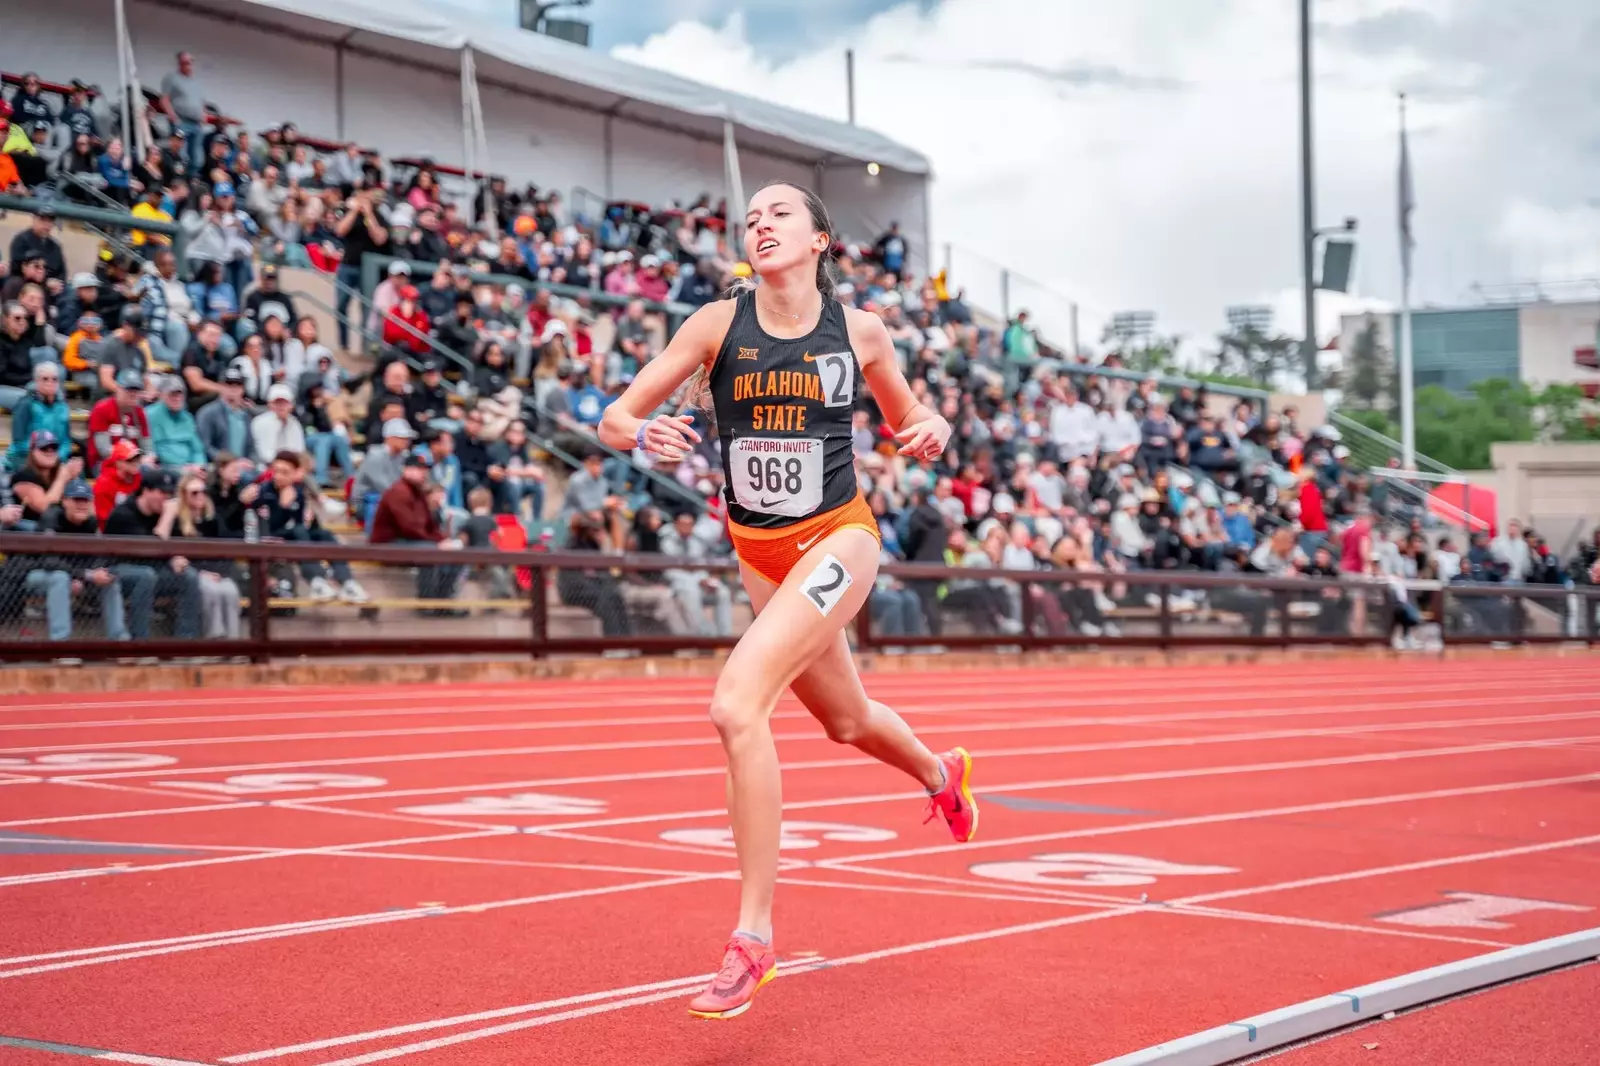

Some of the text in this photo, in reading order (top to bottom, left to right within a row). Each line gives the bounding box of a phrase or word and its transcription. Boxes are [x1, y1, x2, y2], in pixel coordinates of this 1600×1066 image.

[734, 370, 825, 402] OKLAHOM
[825, 355, 848, 404] 2
[752, 405, 807, 431] STATE
[739, 440, 812, 453] STANFORD INVITE
[747, 456, 802, 495] 968
[806, 562, 845, 609] 2
